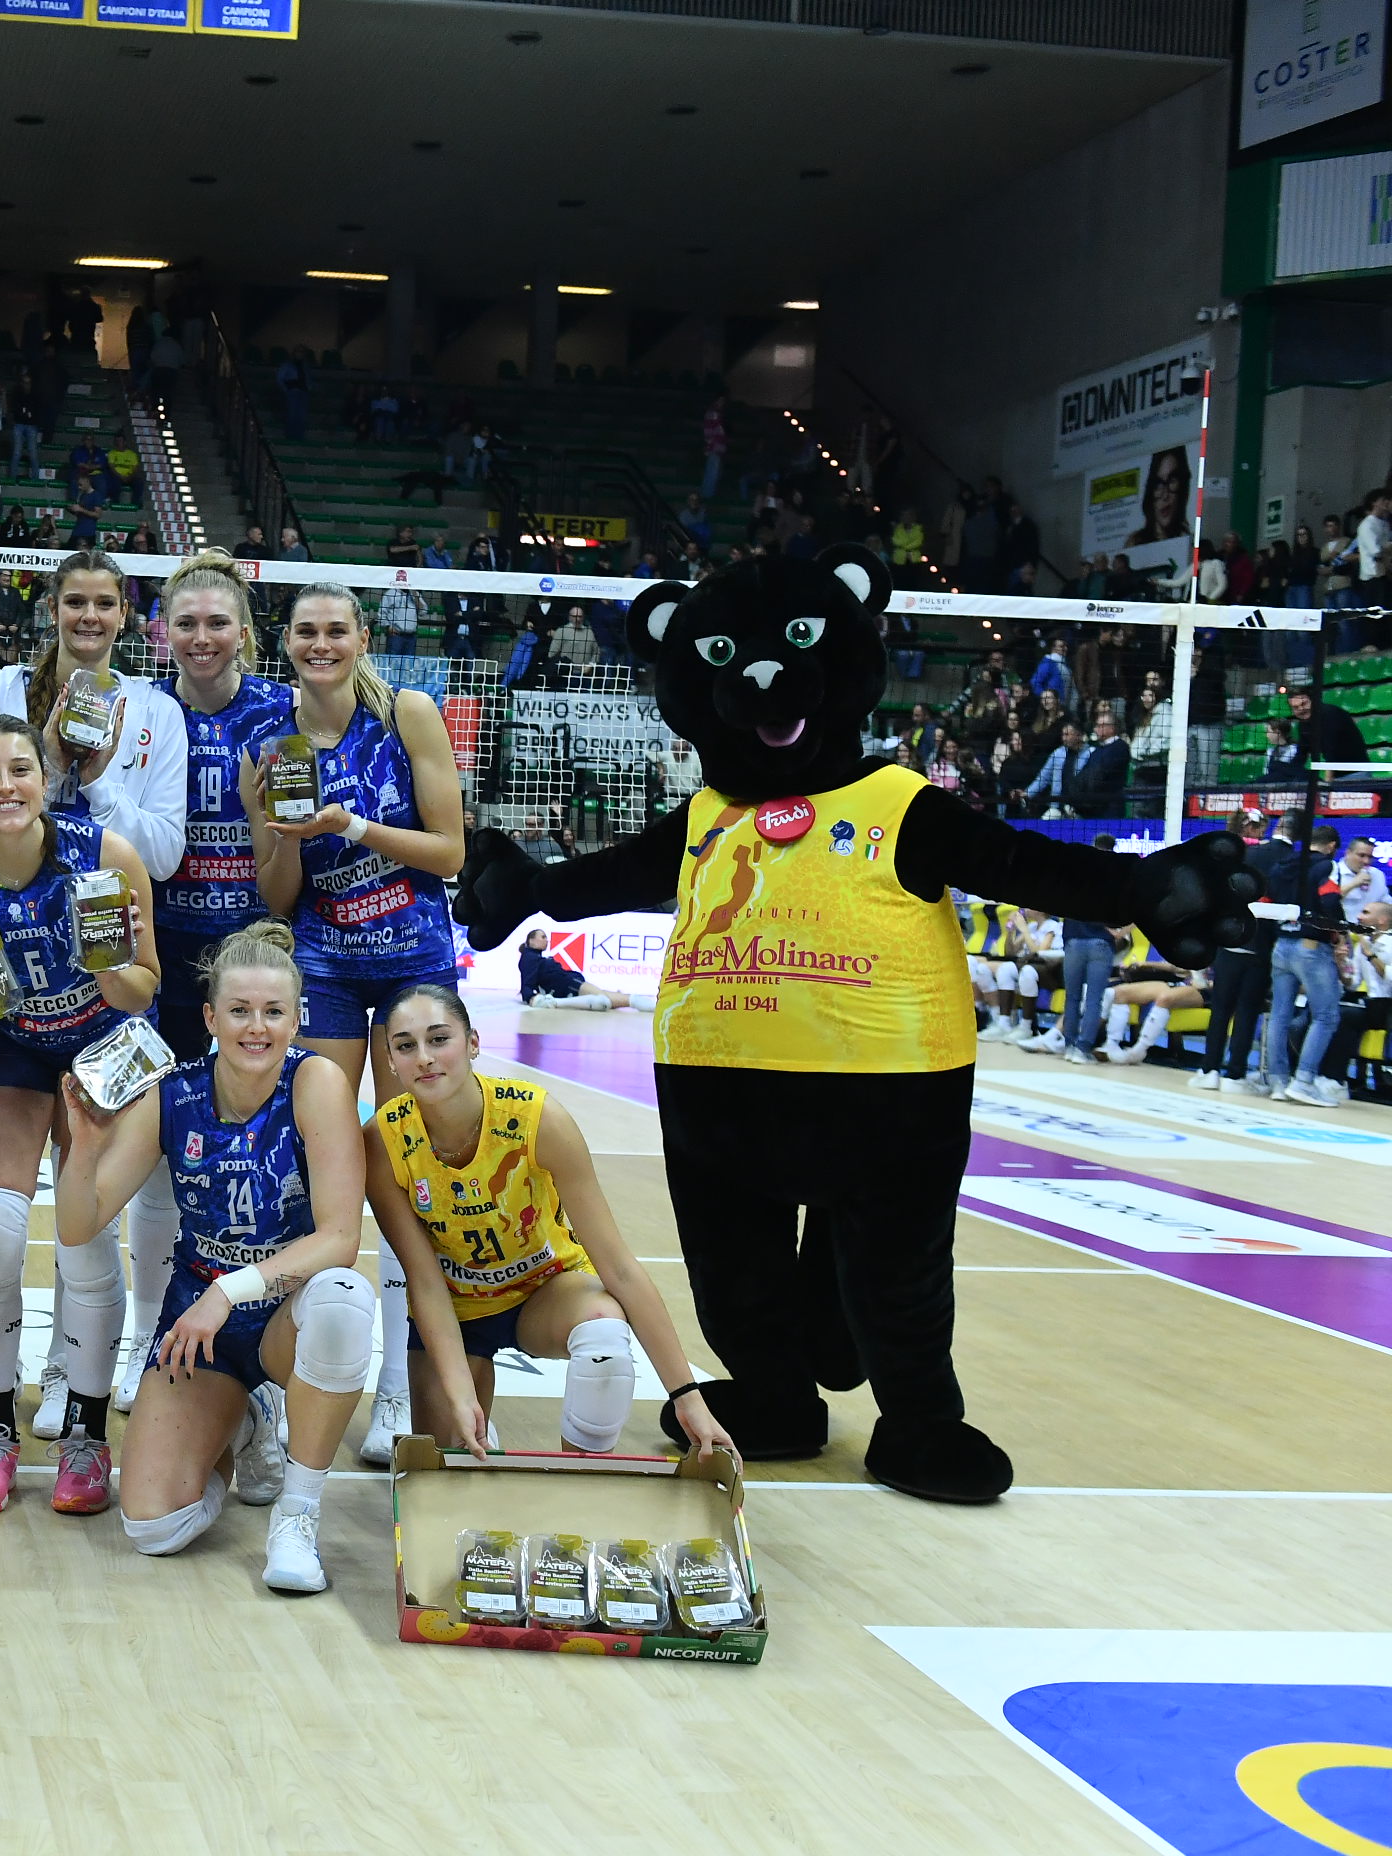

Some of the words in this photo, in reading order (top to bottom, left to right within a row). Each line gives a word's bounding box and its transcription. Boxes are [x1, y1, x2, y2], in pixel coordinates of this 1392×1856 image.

[40, 0, 70, 12] ITALIA
[99, 5, 146, 17] CAMPIONI
[148, 8, 187, 20] D'ITALIA
[222, 6, 270, 18] CAMPIONI
[221, 16, 269, 28] D'EUROPA
[1253, 31, 1371, 95] COSTER
[919, 597, 952, 605] PULSEE
[75, 691, 111, 709] MATERA
[516, 699, 569, 719] WHO
[574, 701, 630, 721] SAYS
[189, 744, 231, 758] Joma
[271, 763, 310, 773] MATERA
[197, 766, 222, 813] 19
[322, 775, 359, 796] Joma
[57, 820, 94, 838] BAXI
[336, 884, 406, 913] ANTONIO
[336, 892, 409, 924] CARRARO
[699, 907, 821, 923] PROSCIUTTI
[4, 925, 51, 943] Joma
[81, 928, 125, 942] MATERA
[343, 926, 393, 946] MORO
[400, 927, 419, 939] 1984
[321, 942, 371, 957] INDUSTRIAL
[373, 937, 419, 956] FORNITURE
[23, 950, 50, 991] 6
[715, 976, 735, 985] SAN
[735, 976, 781, 985] DANIELE
[714, 995, 737, 1011] dal
[743, 996, 779, 1012] 1941
[495, 1086, 534, 1101] BAXI
[226, 1176, 257, 1225] 14
[451, 1201, 496, 1216] Joma
[463, 1227, 506, 1265] 21
[531, 1246, 553, 1266] DOC
[465, 1557, 515, 1568] MATERA
[534, 1560, 584, 1572] MATERA
[678, 1567, 727, 1578] MATERA
[654, 1647, 742, 1662] NICOFRUIT
